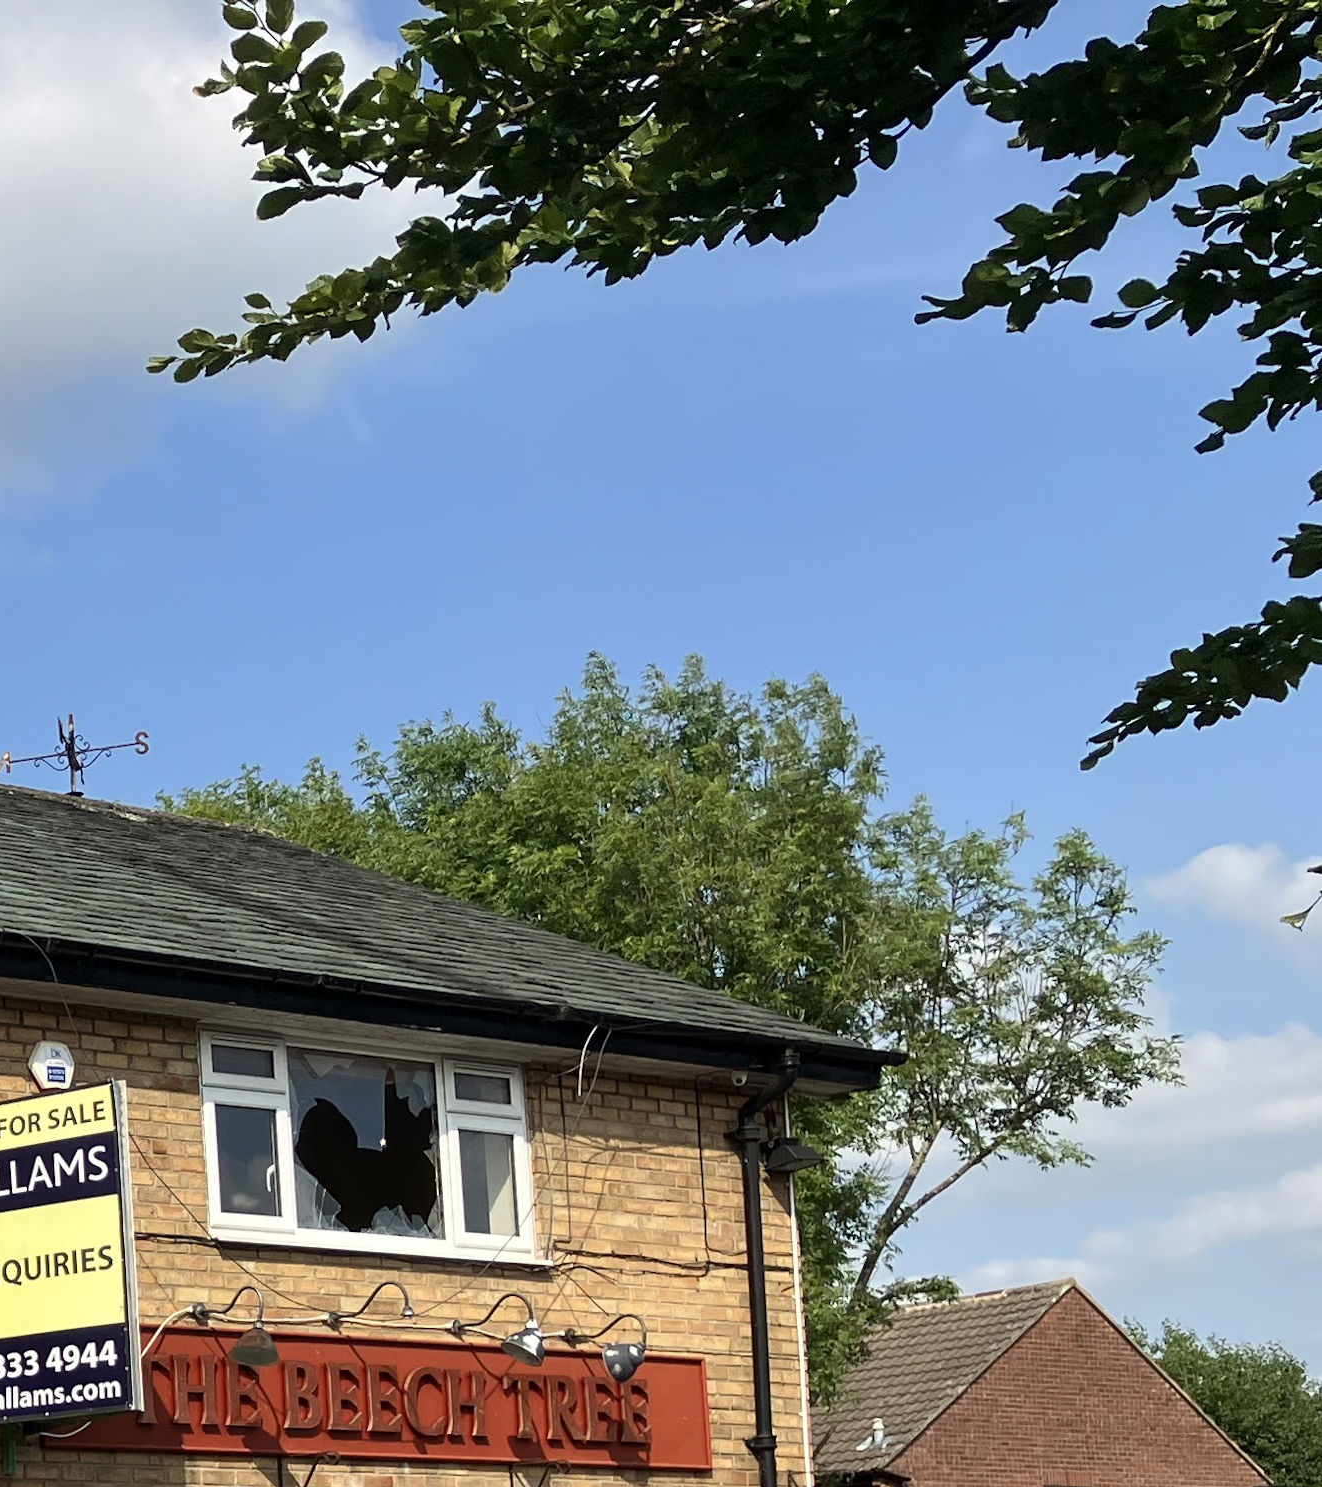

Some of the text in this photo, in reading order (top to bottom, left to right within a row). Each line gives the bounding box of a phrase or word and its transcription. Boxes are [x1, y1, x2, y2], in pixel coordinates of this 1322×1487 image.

[48, 1100, 106, 1129] SALE
[45, 1340, 118, 1373] 4944
[138, 1354, 652, 1443] THE BEECH TREE
